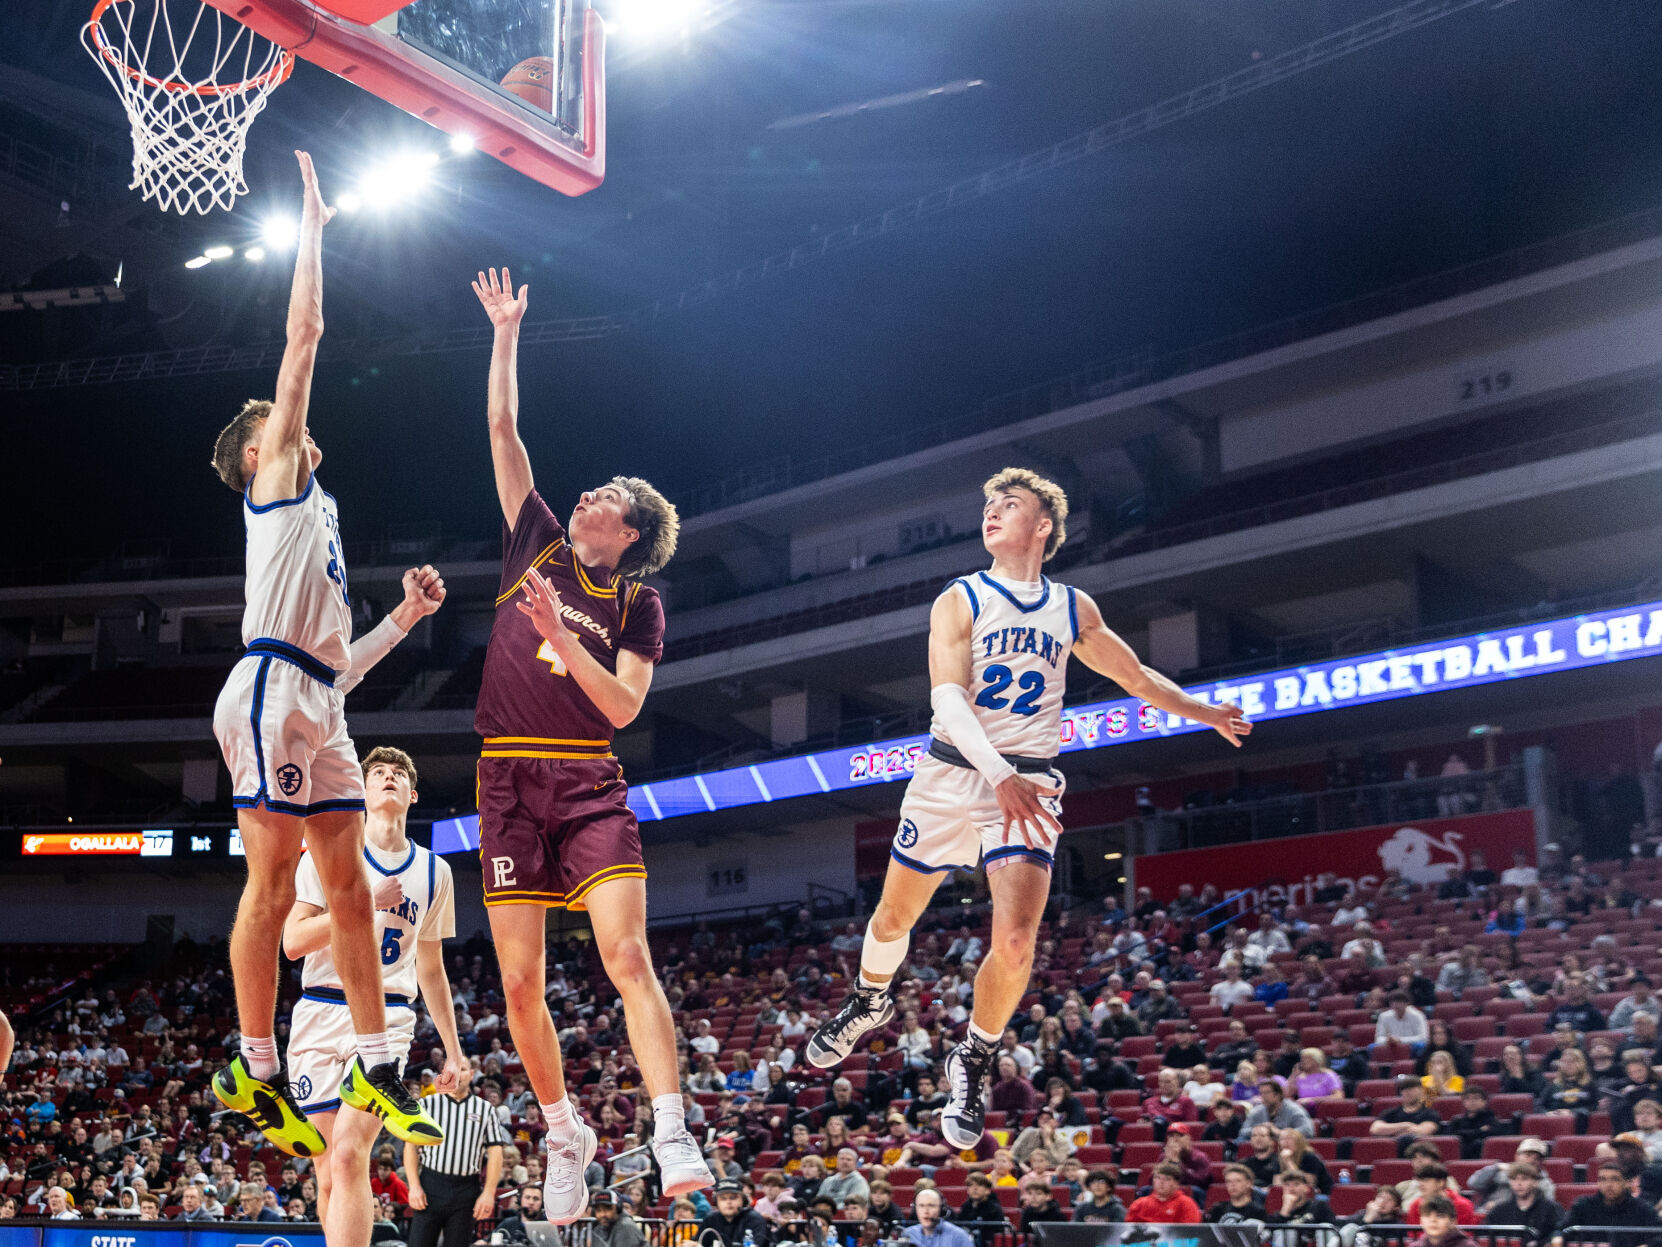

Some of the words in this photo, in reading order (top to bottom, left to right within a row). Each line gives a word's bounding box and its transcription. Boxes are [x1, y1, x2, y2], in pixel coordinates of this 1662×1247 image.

[982, 627, 1063, 669] TITANS
[849, 741, 924, 781] 2025
[1059, 705, 1130, 747] OYS
[1274, 630, 1565, 711] BASKETBALL
[974, 664, 1046, 716] 22
[69, 836, 140, 851] OGALLALA
[190, 835, 212, 851] 1st
[711, 867, 745, 887] 116
[381, 927, 405, 965] 5
